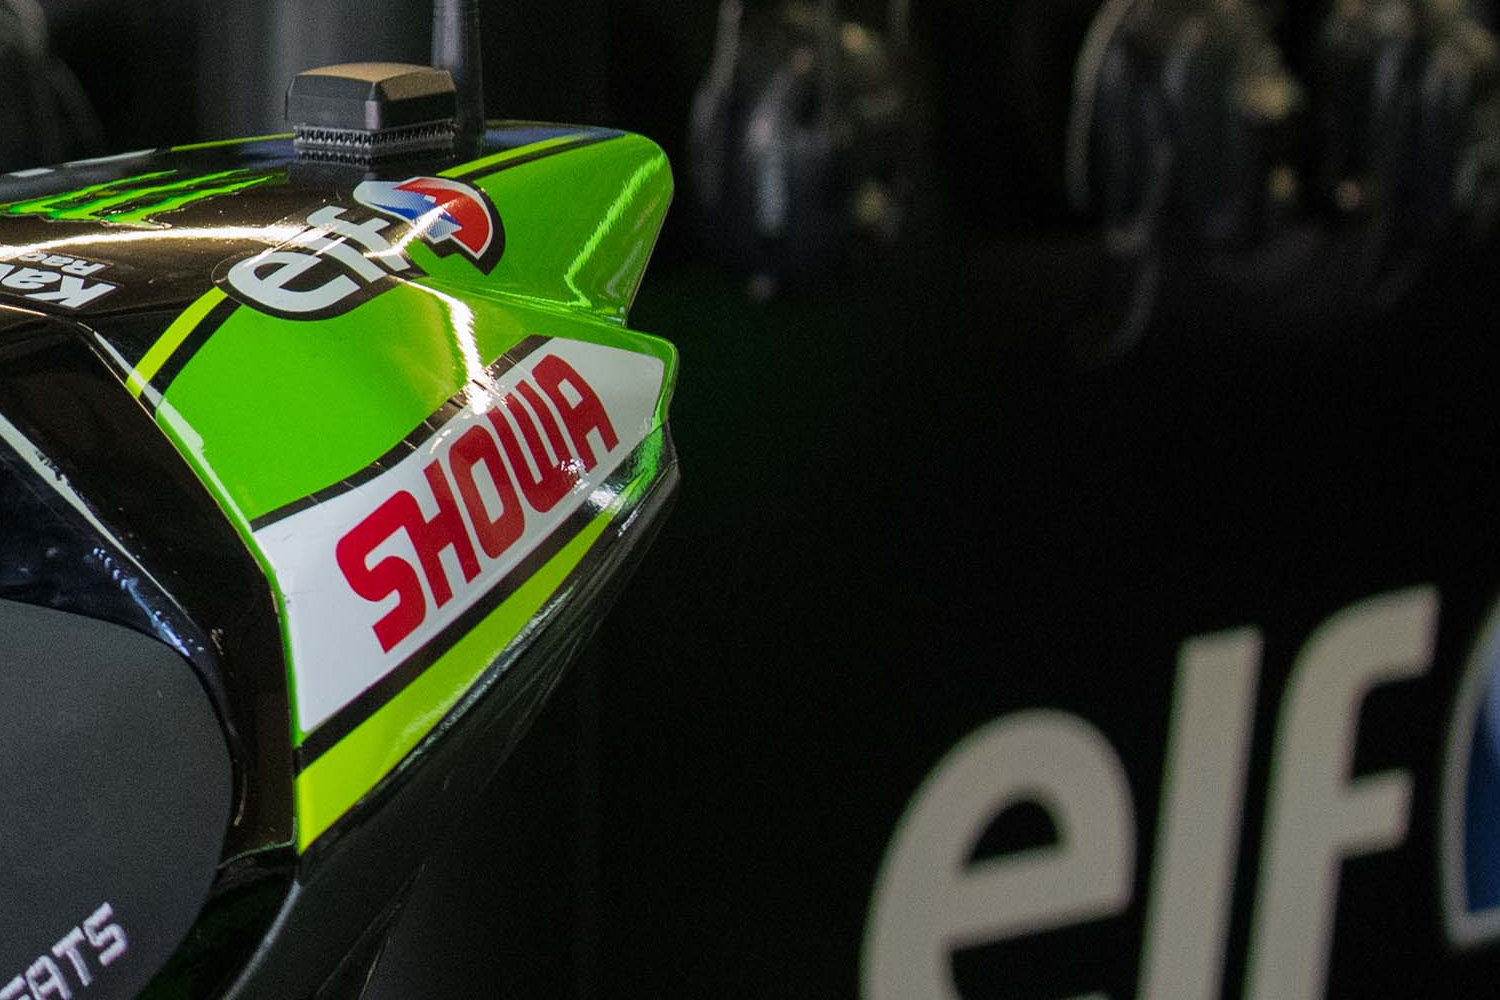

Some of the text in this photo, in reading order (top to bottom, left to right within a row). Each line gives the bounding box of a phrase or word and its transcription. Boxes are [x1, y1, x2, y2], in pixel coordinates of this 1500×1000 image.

[227, 204, 411, 313] elf
[335, 353, 620, 655] SHOWA
[860, 582, 1442, 1000] elf
